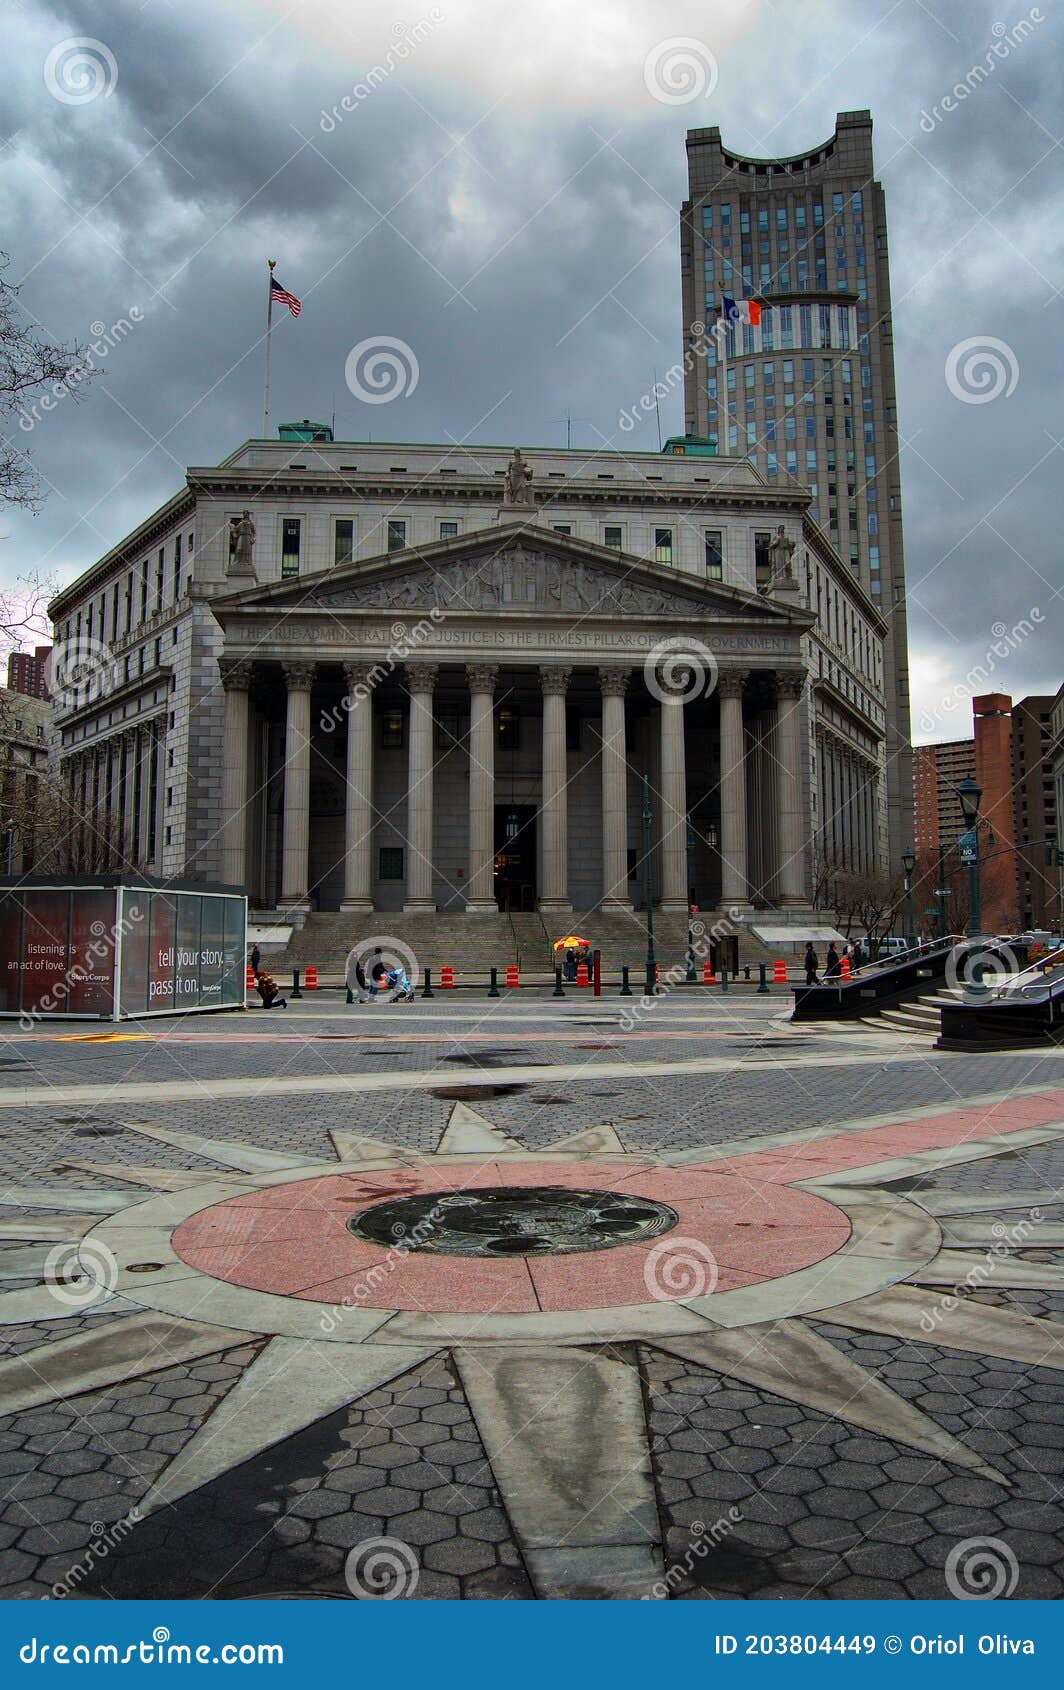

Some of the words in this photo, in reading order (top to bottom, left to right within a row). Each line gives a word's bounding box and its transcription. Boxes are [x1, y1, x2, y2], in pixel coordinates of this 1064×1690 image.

[436, 630, 489, 643] JUSTICE
[494, 631, 505, 643] IS
[509, 631, 532, 643] THE
[537, 632, 589, 645] FIRMEST
[594, 633, 634, 646] PILLAR
[703, 635, 789, 650] GOVERNMENT
[28, 943, 65, 956] listening
[69, 943, 77, 954] is
[158, 947, 174, 967] tell
[177, 951, 199, 970] your
[200, 949, 224, 968] story.
[8, 961, 19, 970] an
[20, 961, 33, 970] act
[35, 960, 45, 970] of
[46, 960, 66, 970] love.
[149, 980, 174, 1001] pass
[175, 975, 183, 993] it
[184, 978, 200, 993] on.
